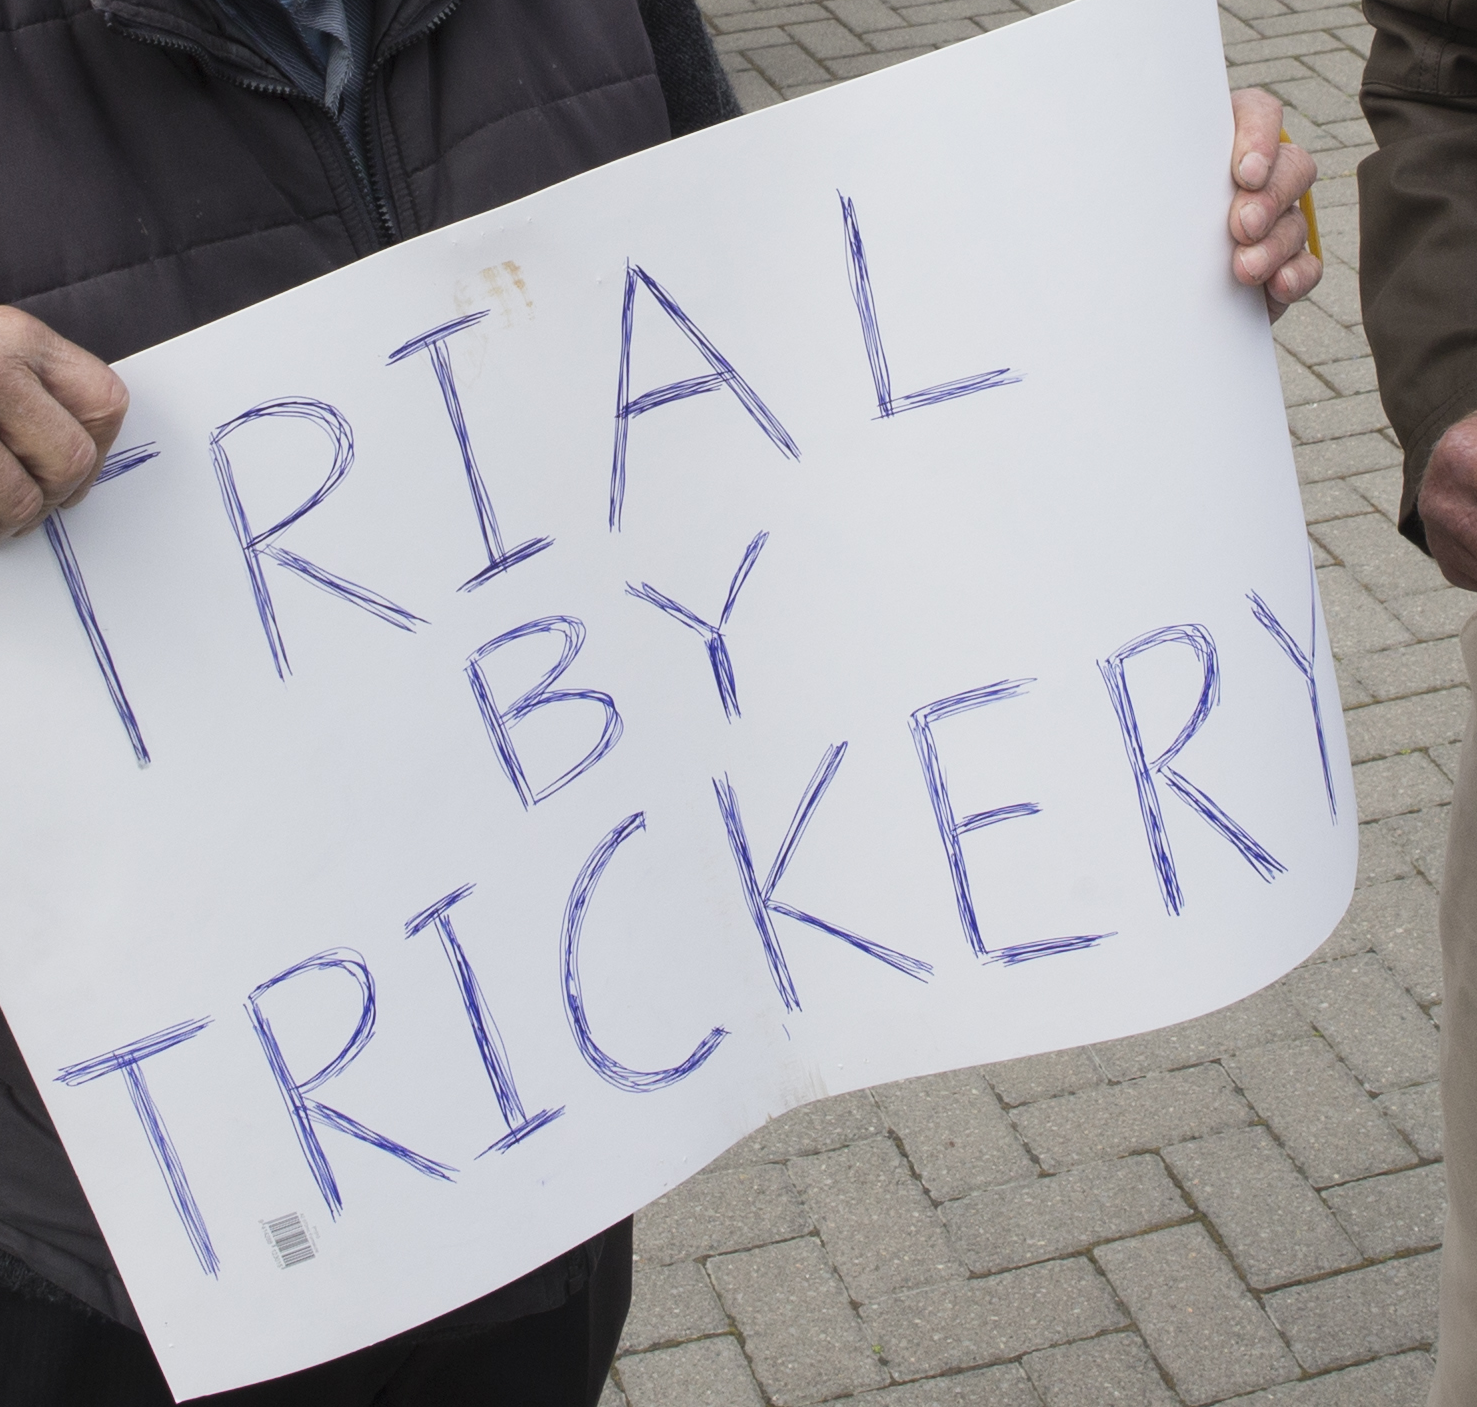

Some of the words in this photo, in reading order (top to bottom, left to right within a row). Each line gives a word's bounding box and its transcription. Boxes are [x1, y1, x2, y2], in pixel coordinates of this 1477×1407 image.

[42, 188, 1022, 765] TRIAL
[462, 529, 770, 809] BY
[53, 541, 1338, 1279] TRICKERY
